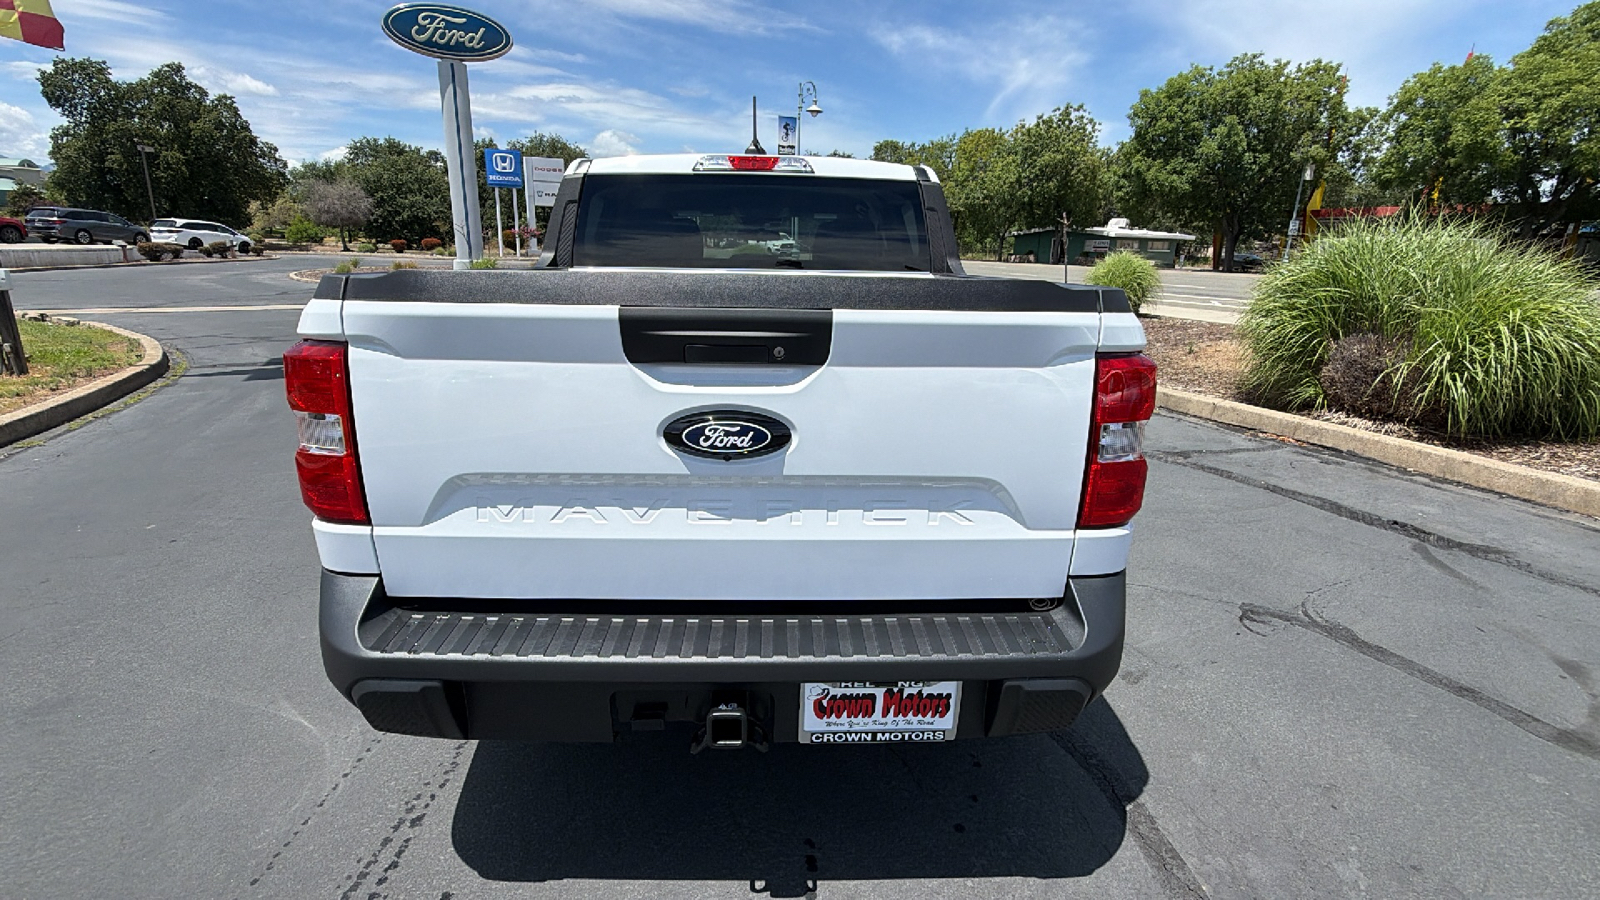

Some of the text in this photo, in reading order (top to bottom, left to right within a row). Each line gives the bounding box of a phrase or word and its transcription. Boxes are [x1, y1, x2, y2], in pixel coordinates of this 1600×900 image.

[411, 11, 486, 49] Ford
[489, 174, 521, 182] HONDA
[699, 425, 754, 448] Ford
[476, 498, 976, 525] MAVERICK
[813, 688, 952, 720] Crown Motors
[871, 719, 888, 727] King
[891, 719, 900, 727] Of
[811, 731, 945, 743] CROWN MOTORS
